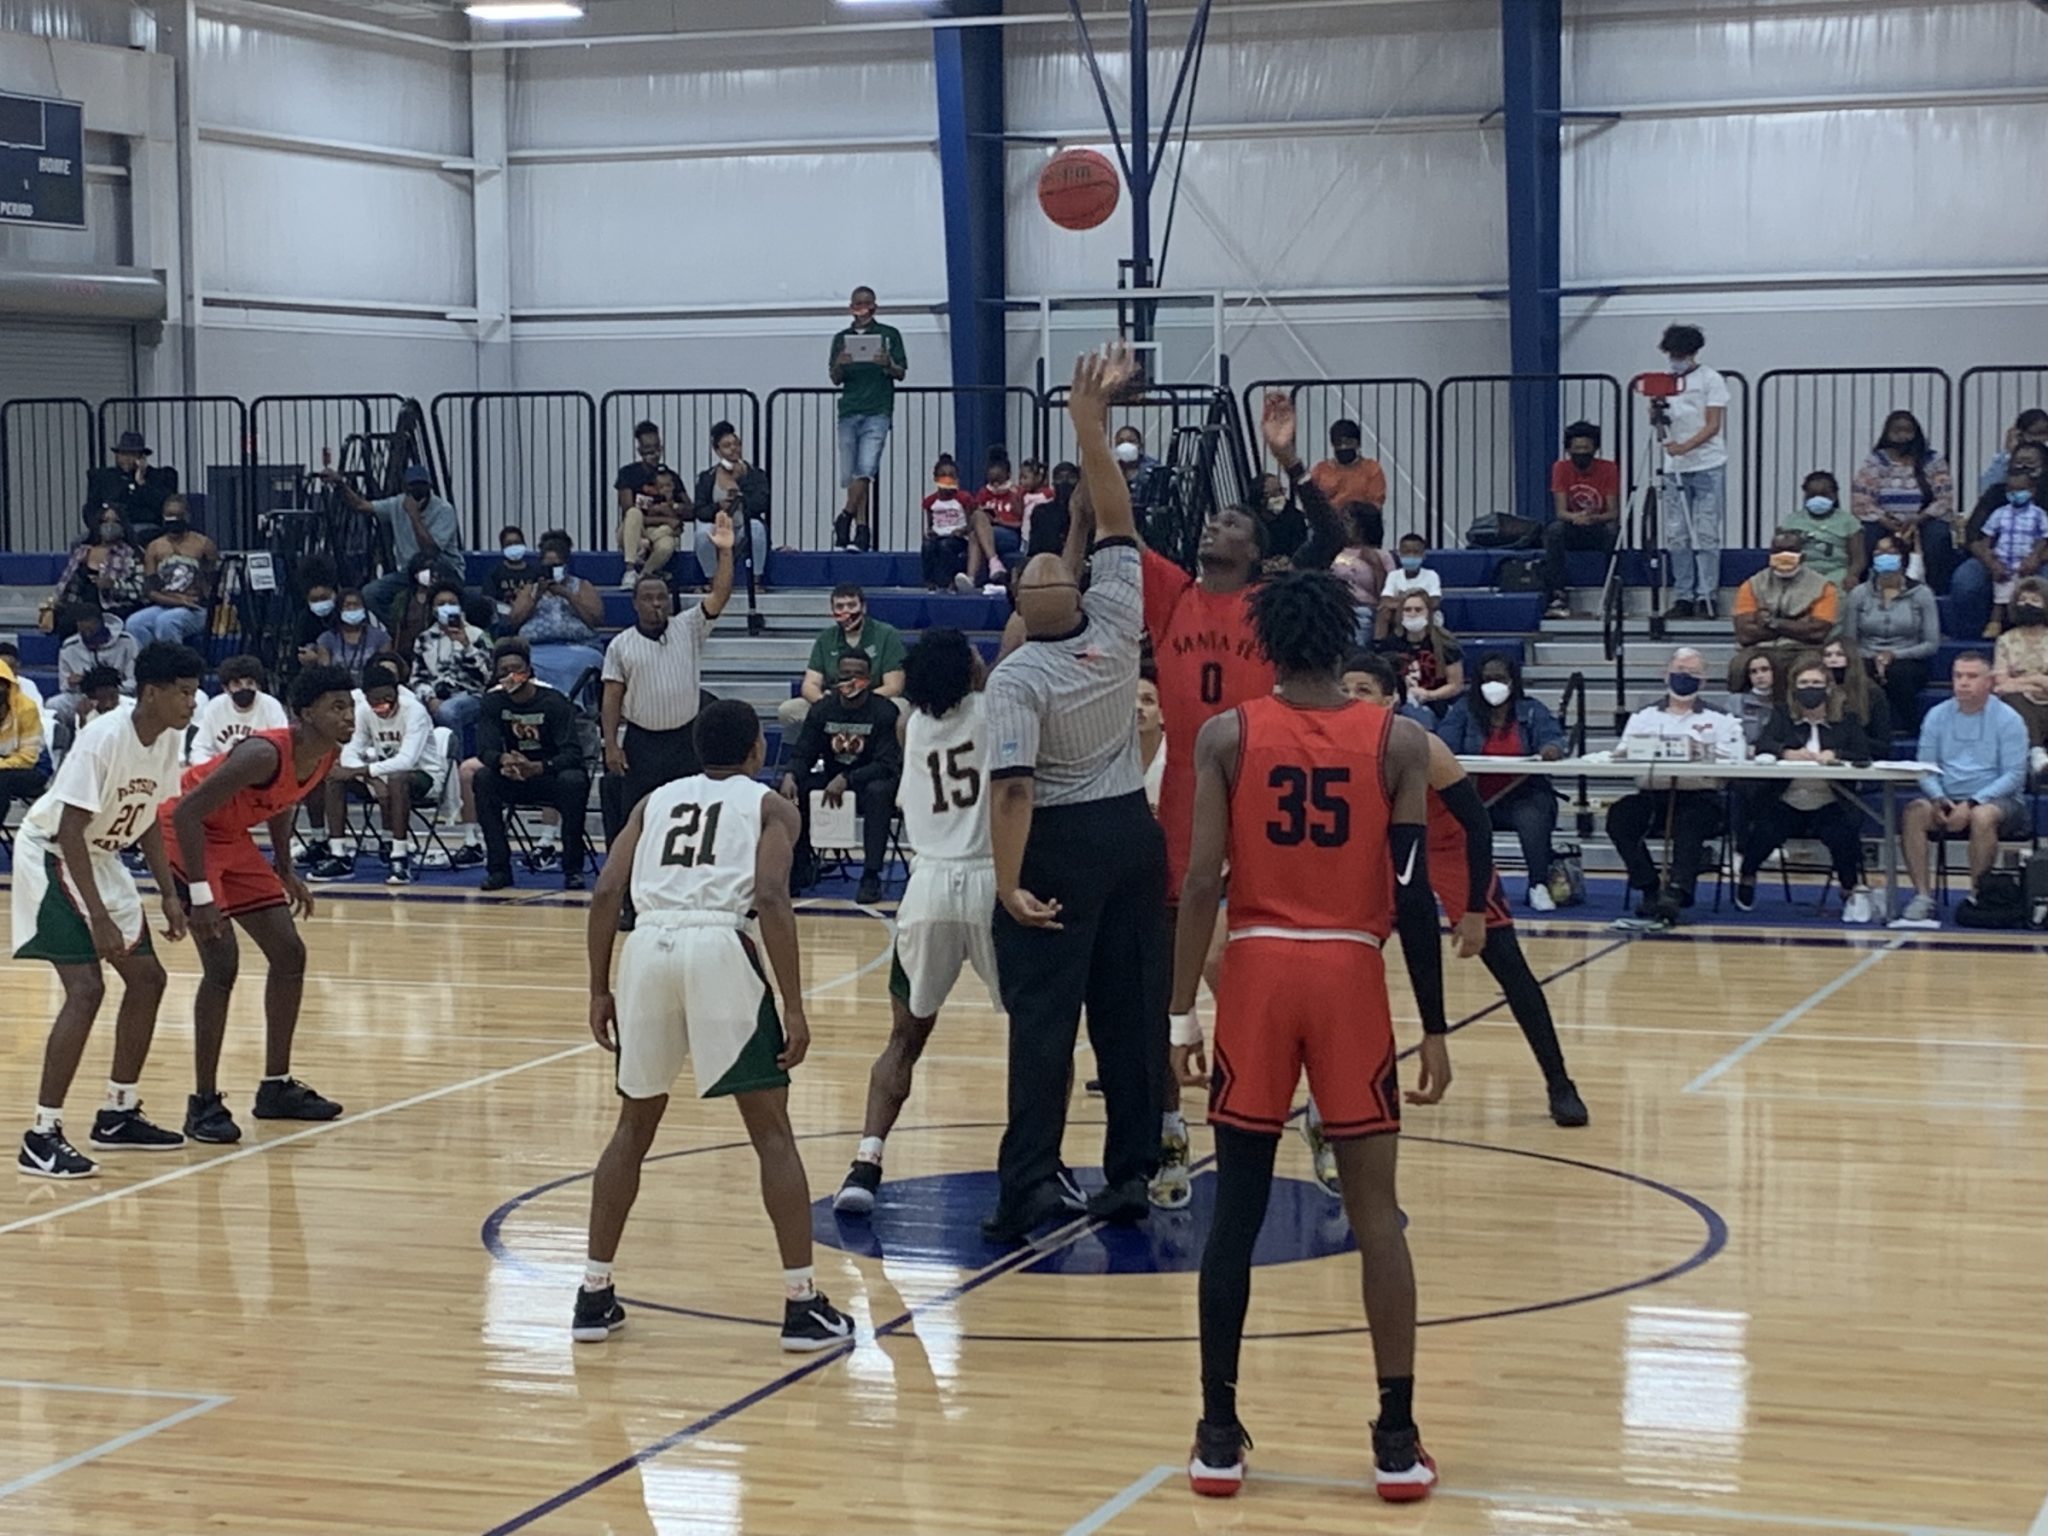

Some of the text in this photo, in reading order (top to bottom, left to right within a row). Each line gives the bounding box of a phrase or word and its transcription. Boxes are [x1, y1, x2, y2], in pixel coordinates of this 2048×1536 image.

[1172, 629, 1231, 656] SANTA
[1201, 662, 1222, 705] 0
[926, 739, 980, 814] 15
[1266, 764, 1350, 848] 35
[660, 800, 724, 868] 21
